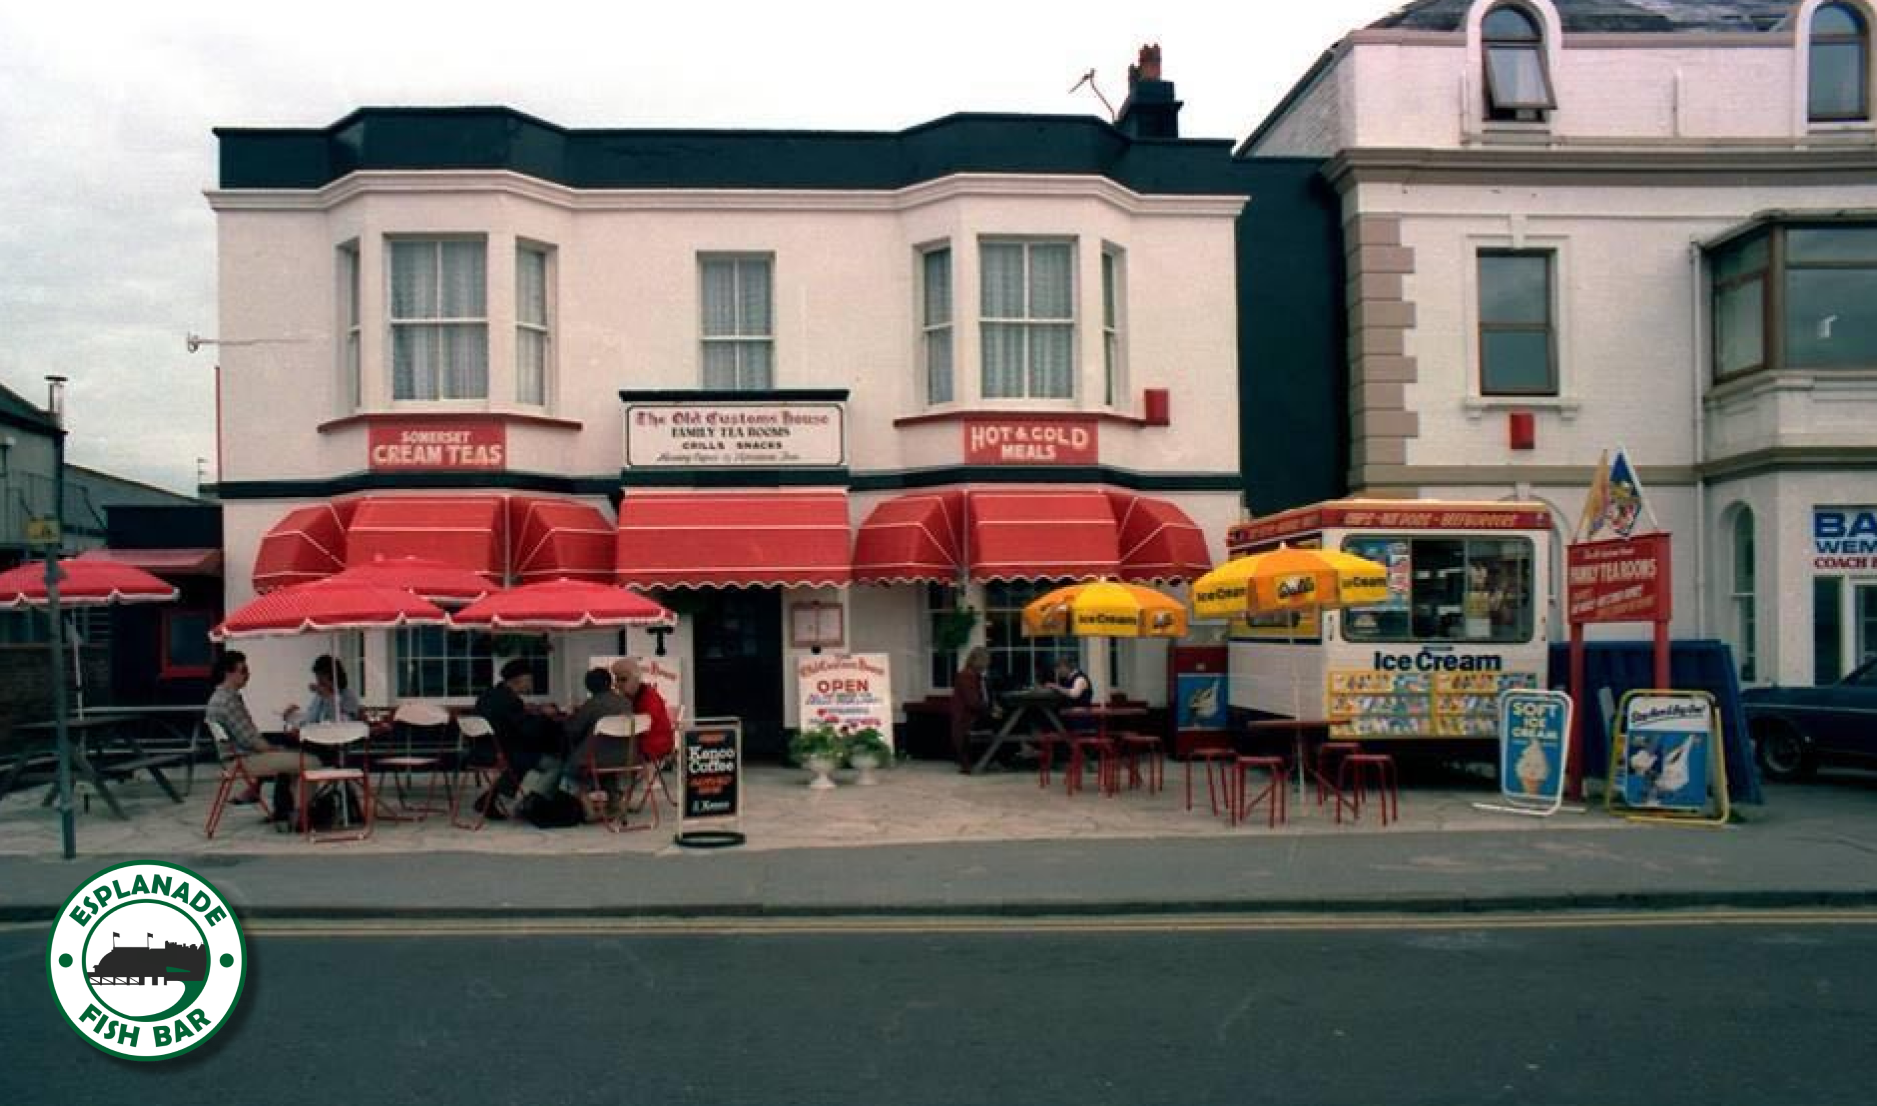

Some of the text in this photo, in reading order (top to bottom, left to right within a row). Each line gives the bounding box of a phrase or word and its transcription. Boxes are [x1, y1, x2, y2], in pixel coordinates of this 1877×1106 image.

[636, 411, 665, 426] The
[672, 411, 700, 424] Old
[705, 411, 777, 424] Customs
[402, 430, 472, 443] SOMERSET
[671, 427, 791, 437] FAMILY TEA ROOMS
[971, 425, 1089, 453] HOT & COLD
[736, 441, 783, 450] SNACKS
[1001, 443, 1057, 460] MEALS
[373, 444, 502, 465] CREAM TEAS
[1813, 556, 1868, 569] COACH
[1373, 650, 1502, 672] Ice Cream
[816, 679, 869, 693] OPEN
[1513, 702, 1558, 718] SOFT
[1523, 718, 1546, 730] ICE
[1511, 727, 1559, 740] CREAM
